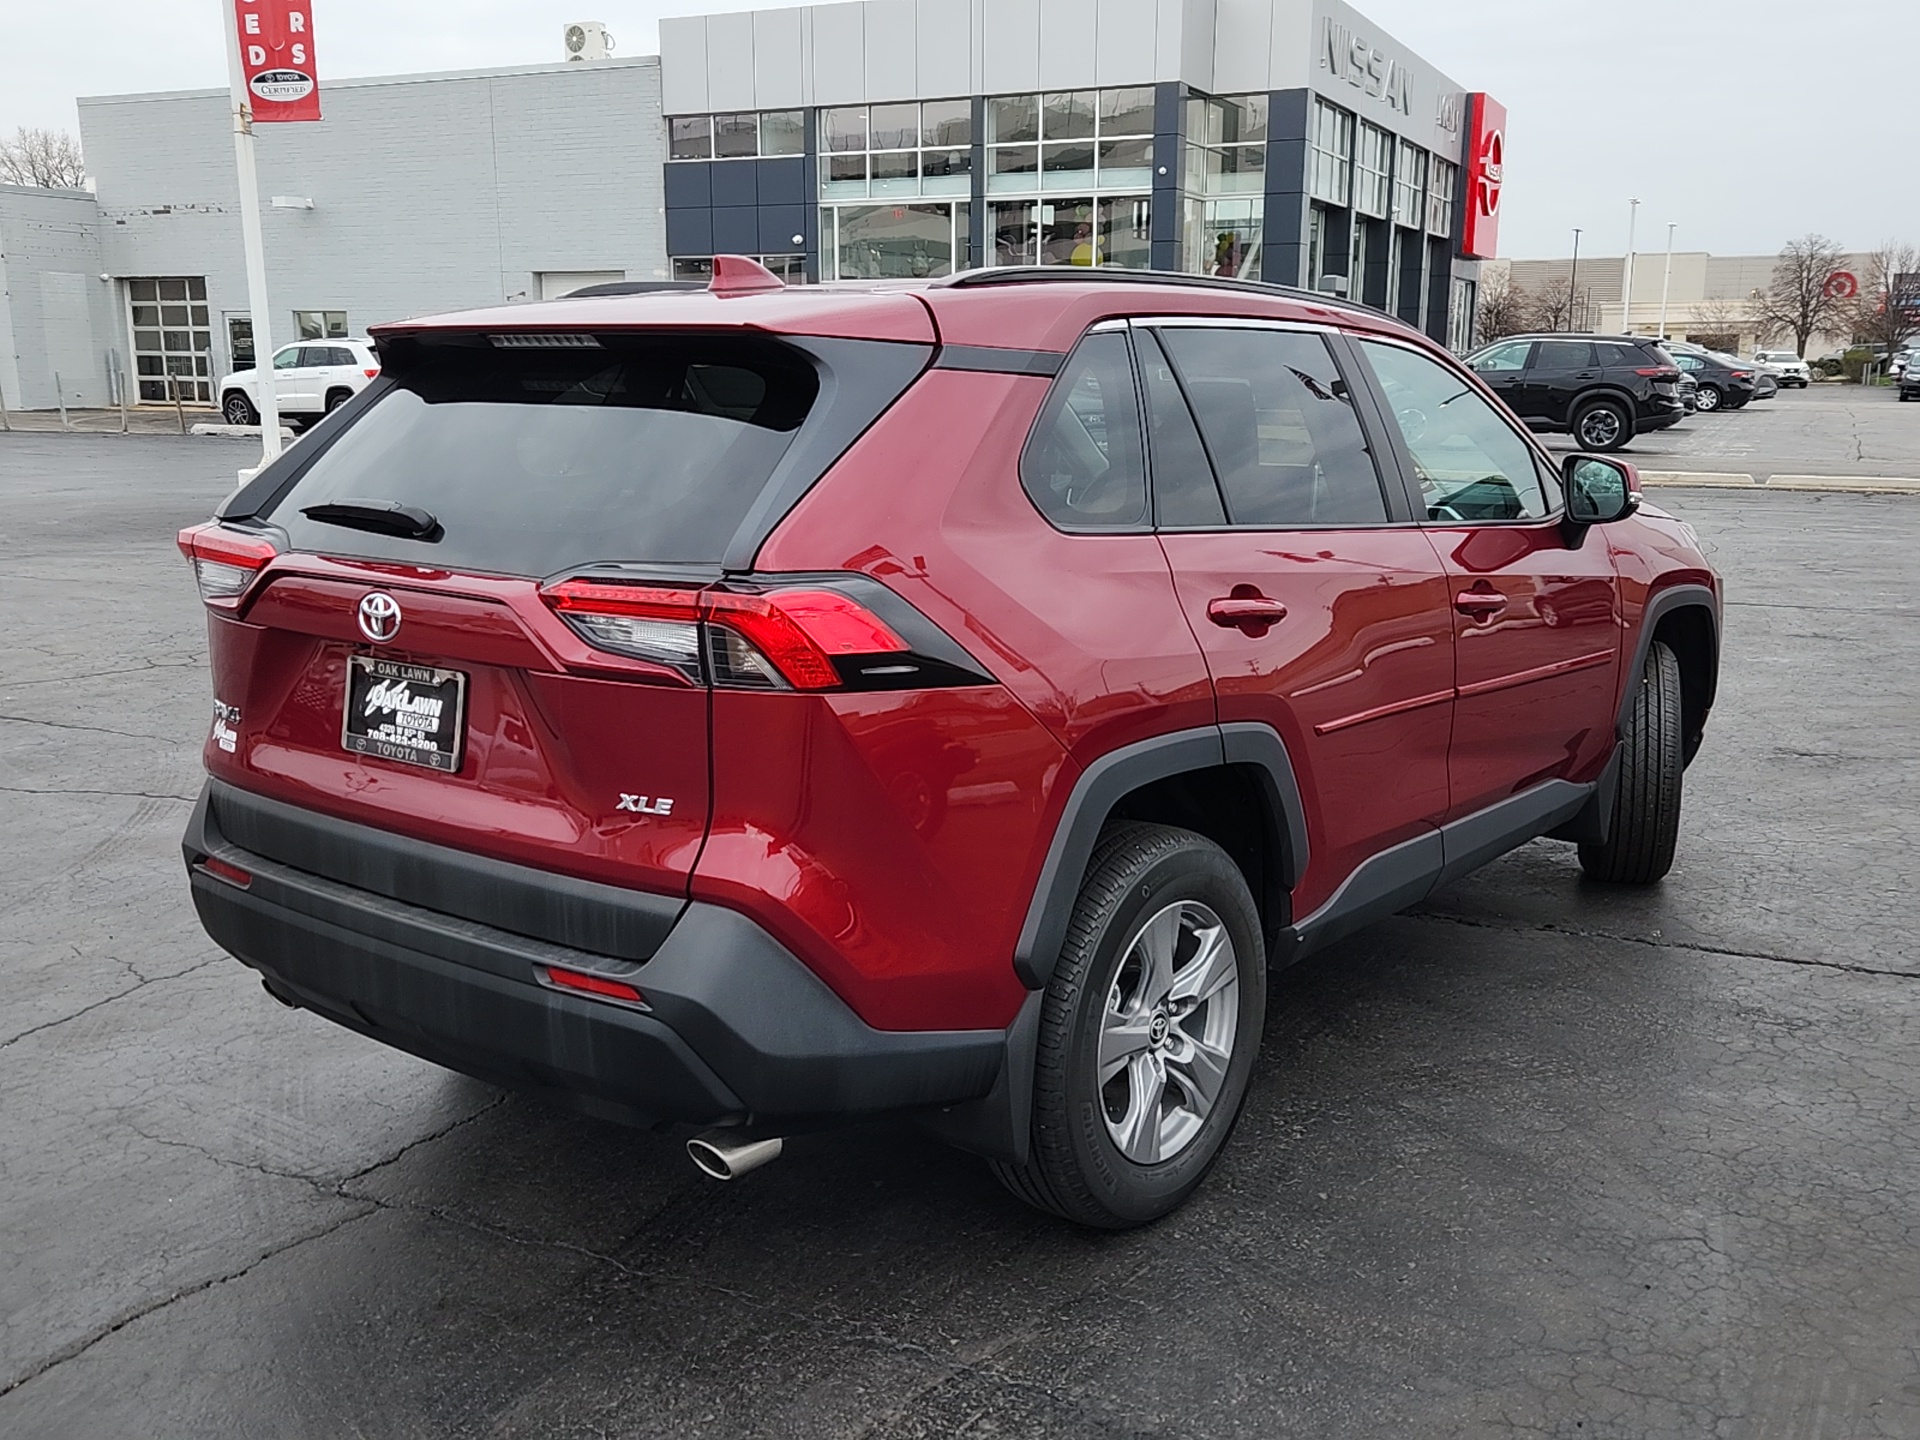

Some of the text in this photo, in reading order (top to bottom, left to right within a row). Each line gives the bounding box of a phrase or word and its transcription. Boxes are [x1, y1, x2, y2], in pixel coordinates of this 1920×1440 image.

[1320, 16, 1415, 116] NISSAN
[378, 662, 430, 682] OAK LAWN
[401, 713, 434, 730] TOYOTA
[367, 729, 438, 751] 708-423-5200
[377, 741, 418, 761] TOYOTA
[615, 792, 674, 816] XLE
